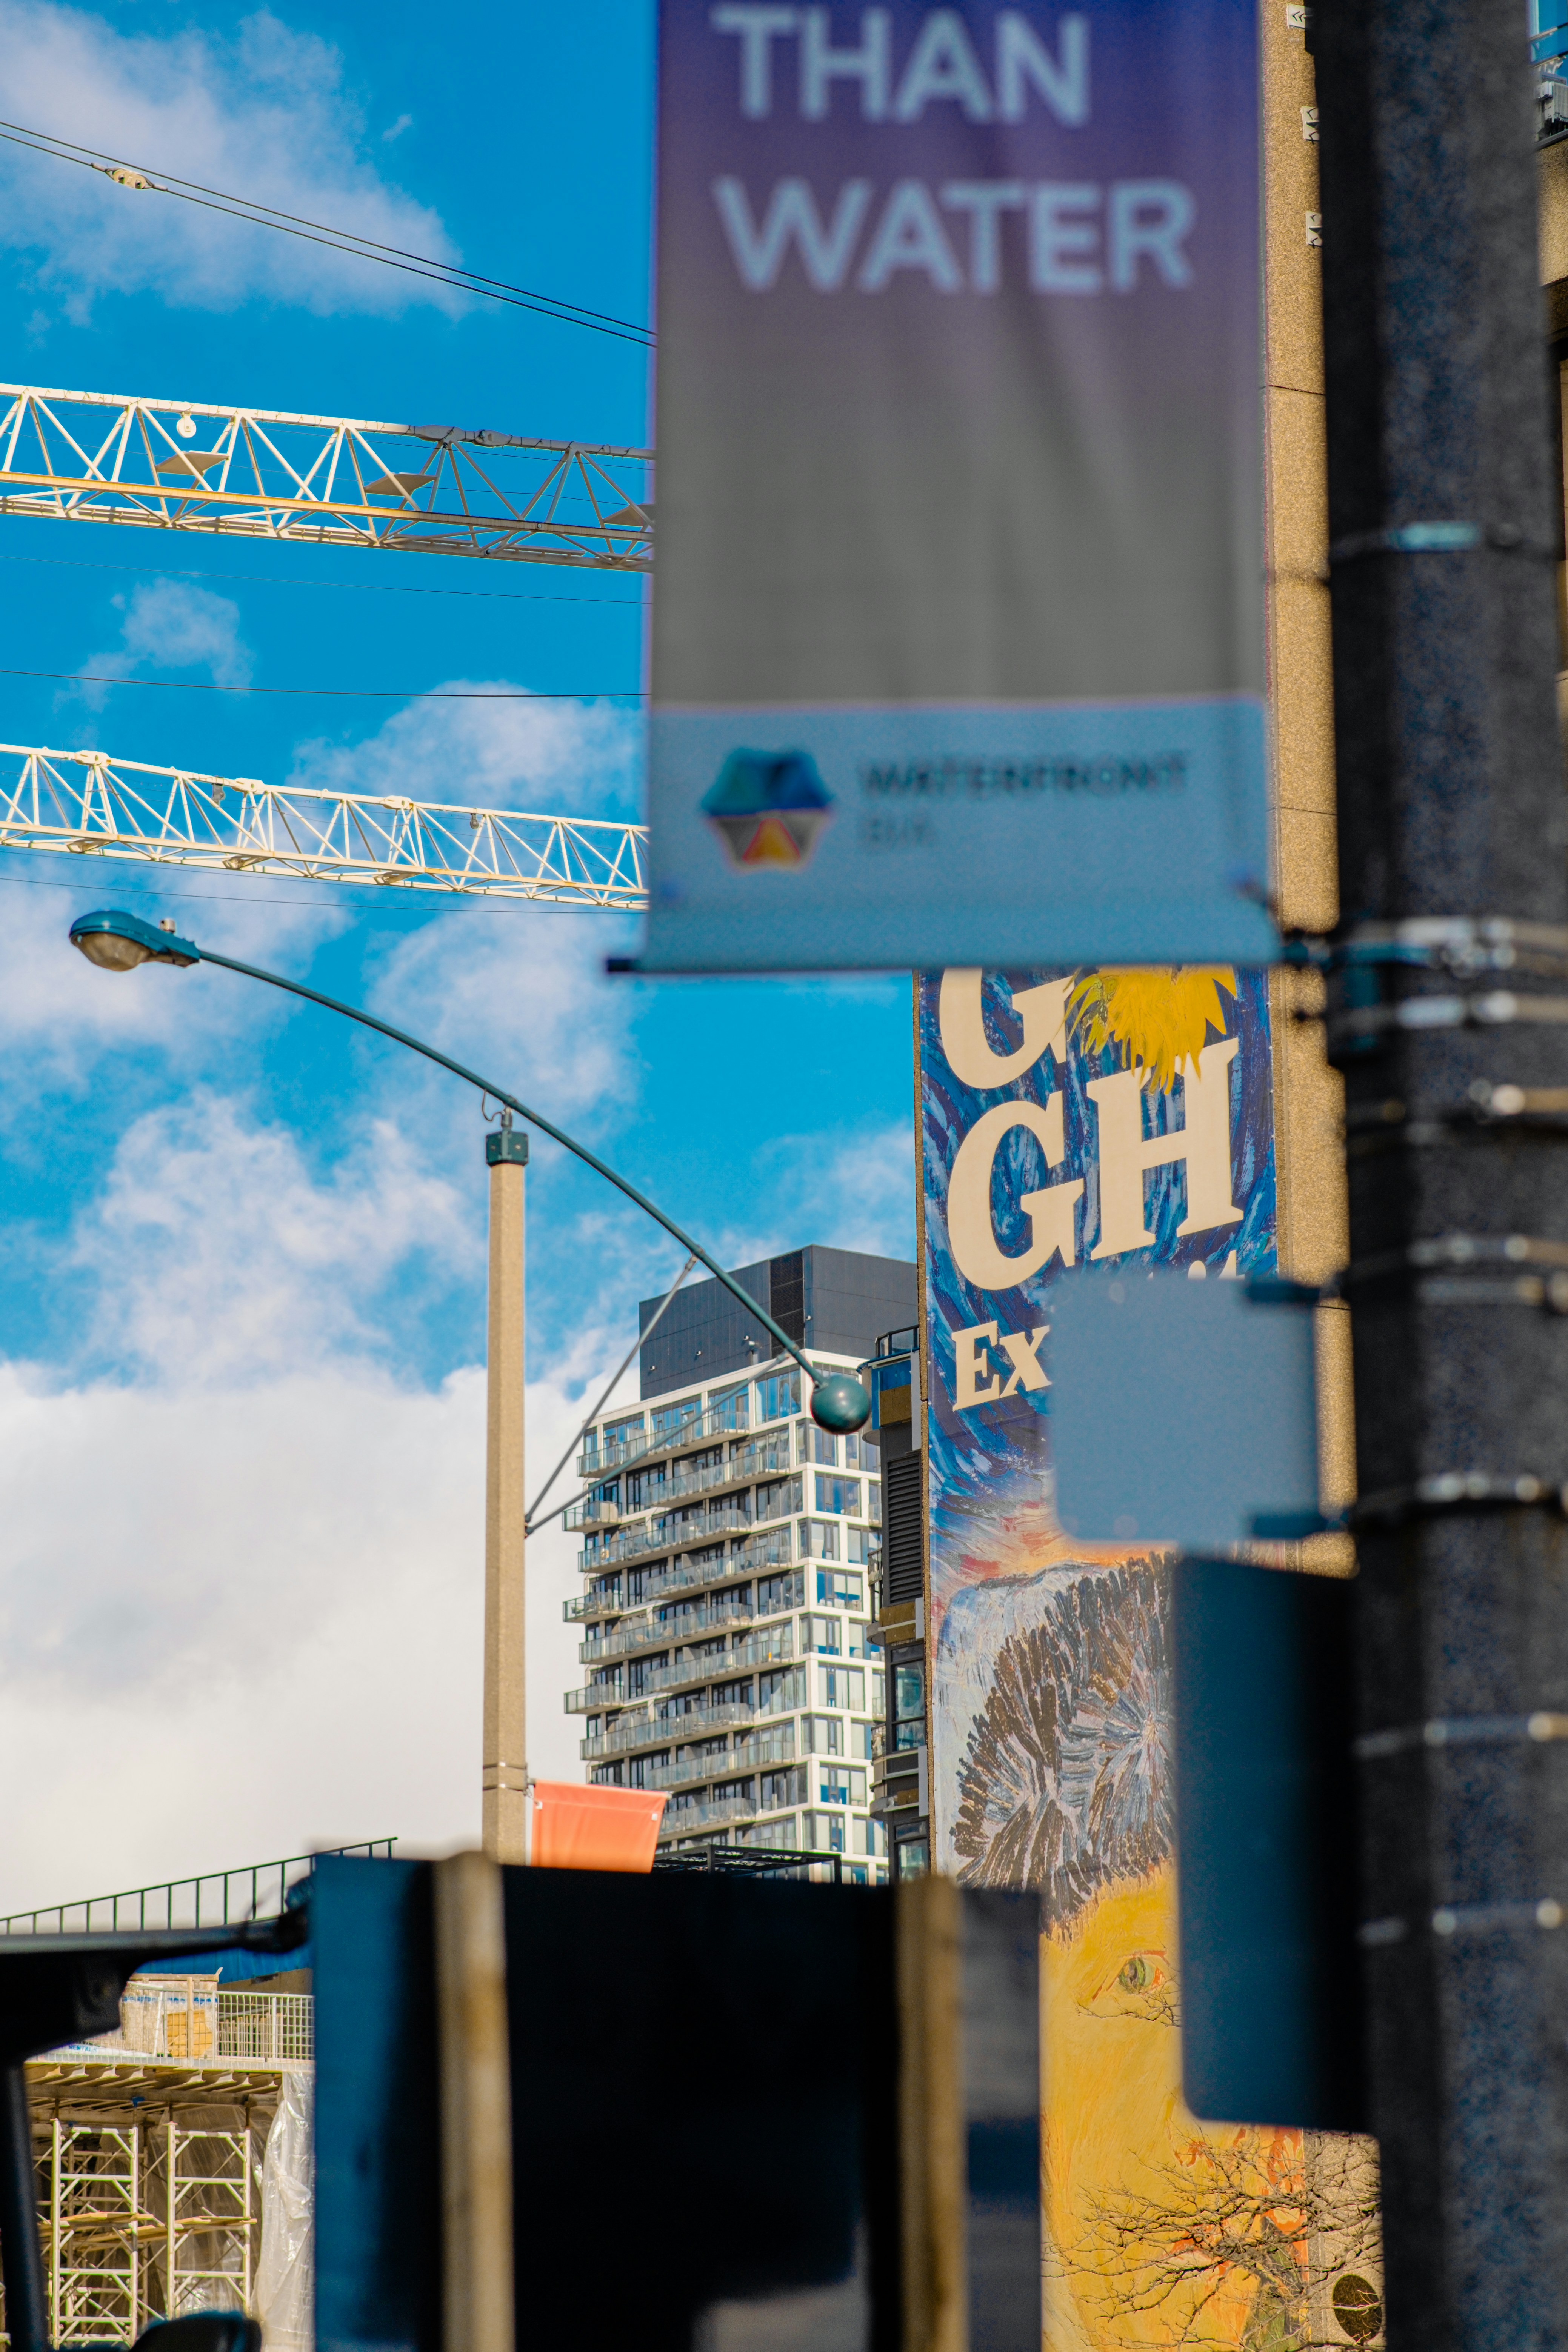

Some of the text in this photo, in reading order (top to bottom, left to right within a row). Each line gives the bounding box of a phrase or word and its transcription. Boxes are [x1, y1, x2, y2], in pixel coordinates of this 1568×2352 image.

[710, 6, 1091, 126] THAN
[712, 177, 1196, 294] WATER
[948, 1038, 1244, 1291] GH
